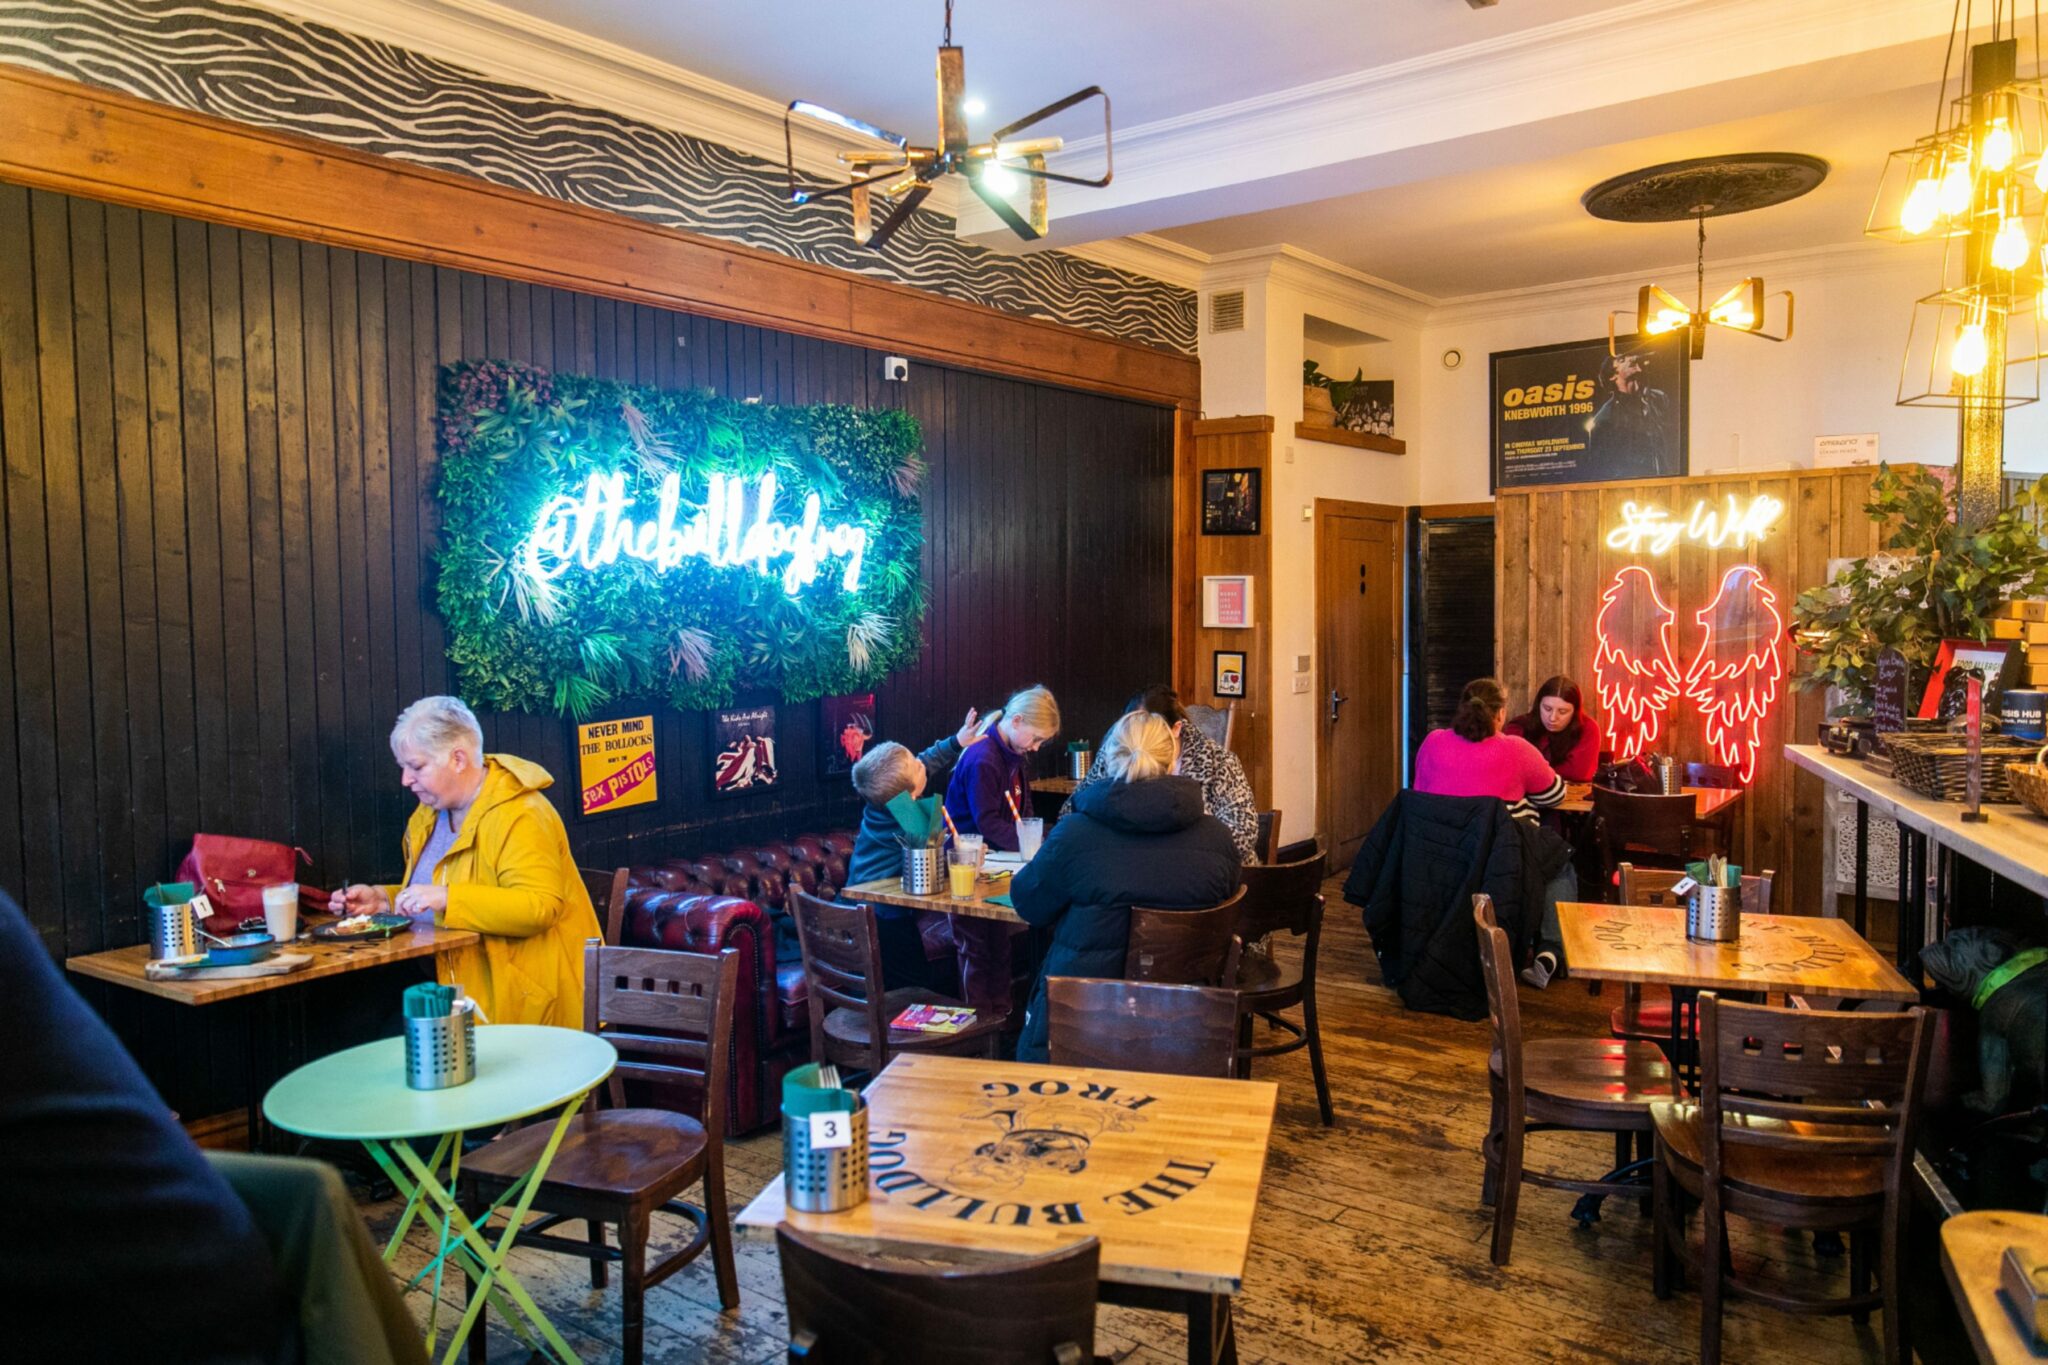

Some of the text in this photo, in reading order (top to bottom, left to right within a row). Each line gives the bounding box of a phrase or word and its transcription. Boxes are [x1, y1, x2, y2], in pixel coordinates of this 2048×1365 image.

[1503, 374, 1595, 407] oasis
[1504, 401, 1594, 421] KNEBWORTH 1996
[1511, 440, 1536, 449] CINEMAS
[1536, 437, 1570, 447] WORLDWIDE
[1516, 446, 1544, 455] THURSDAY
[1552, 442, 1586, 452] SEPTEMBER
[2021, 710, 2042, 719] HUB
[588, 720, 644, 739] NEVER MIND
[581, 734, 653, 755] THE BOLLOCKS
[200, 901, 207, 912] 1
[1591, 919, 1642, 950] FROG
[982, 1080, 1158, 1111] FROG
[824, 1120, 838, 1139] 3
[868, 1130, 1217, 1227] THE BULLDOG
